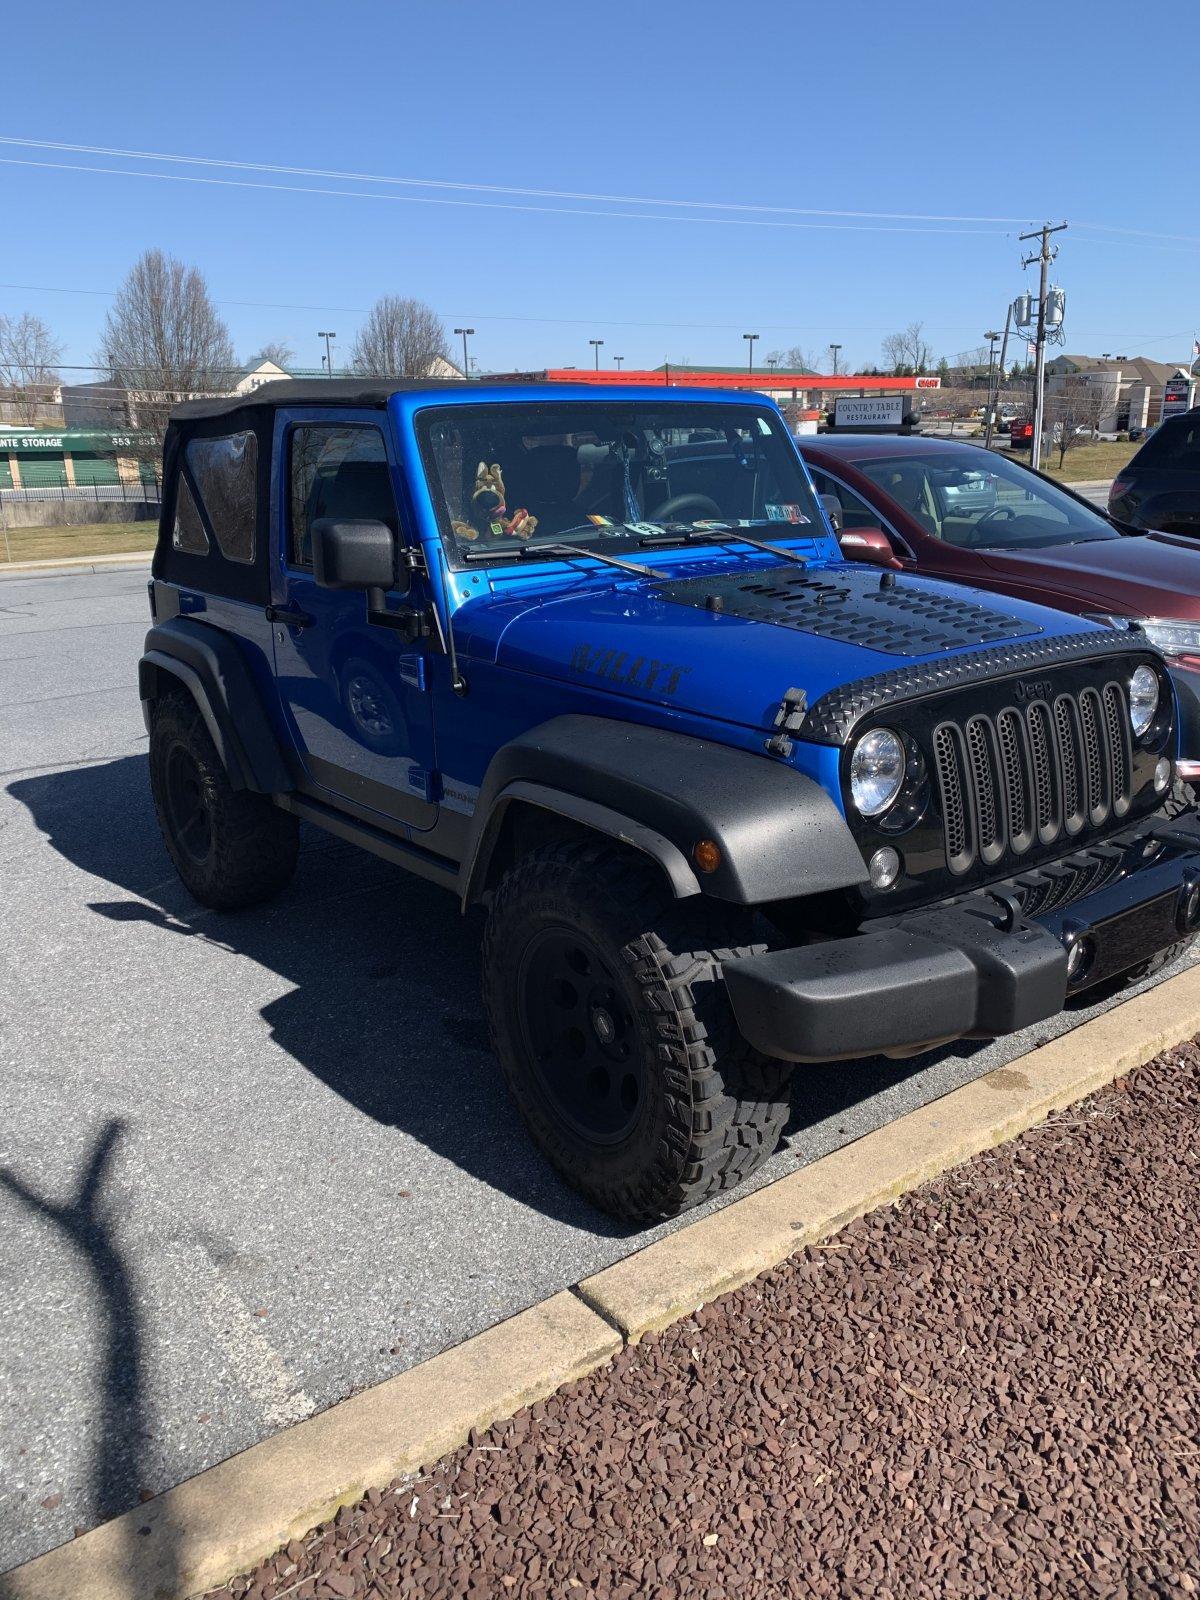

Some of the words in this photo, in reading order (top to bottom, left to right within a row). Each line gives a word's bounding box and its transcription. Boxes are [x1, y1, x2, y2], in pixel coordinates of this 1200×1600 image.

[838, 403, 874, 413] COUNTRY
[876, 402, 901, 411] TABLE
[846, 413, 890, 421] RESTAURANT
[0, 438, 18, 447] NTE
[22, 438, 63, 447] STORAGE
[568, 641, 694, 695] WILLYS
[1014, 680, 1052, 702] Jeep
